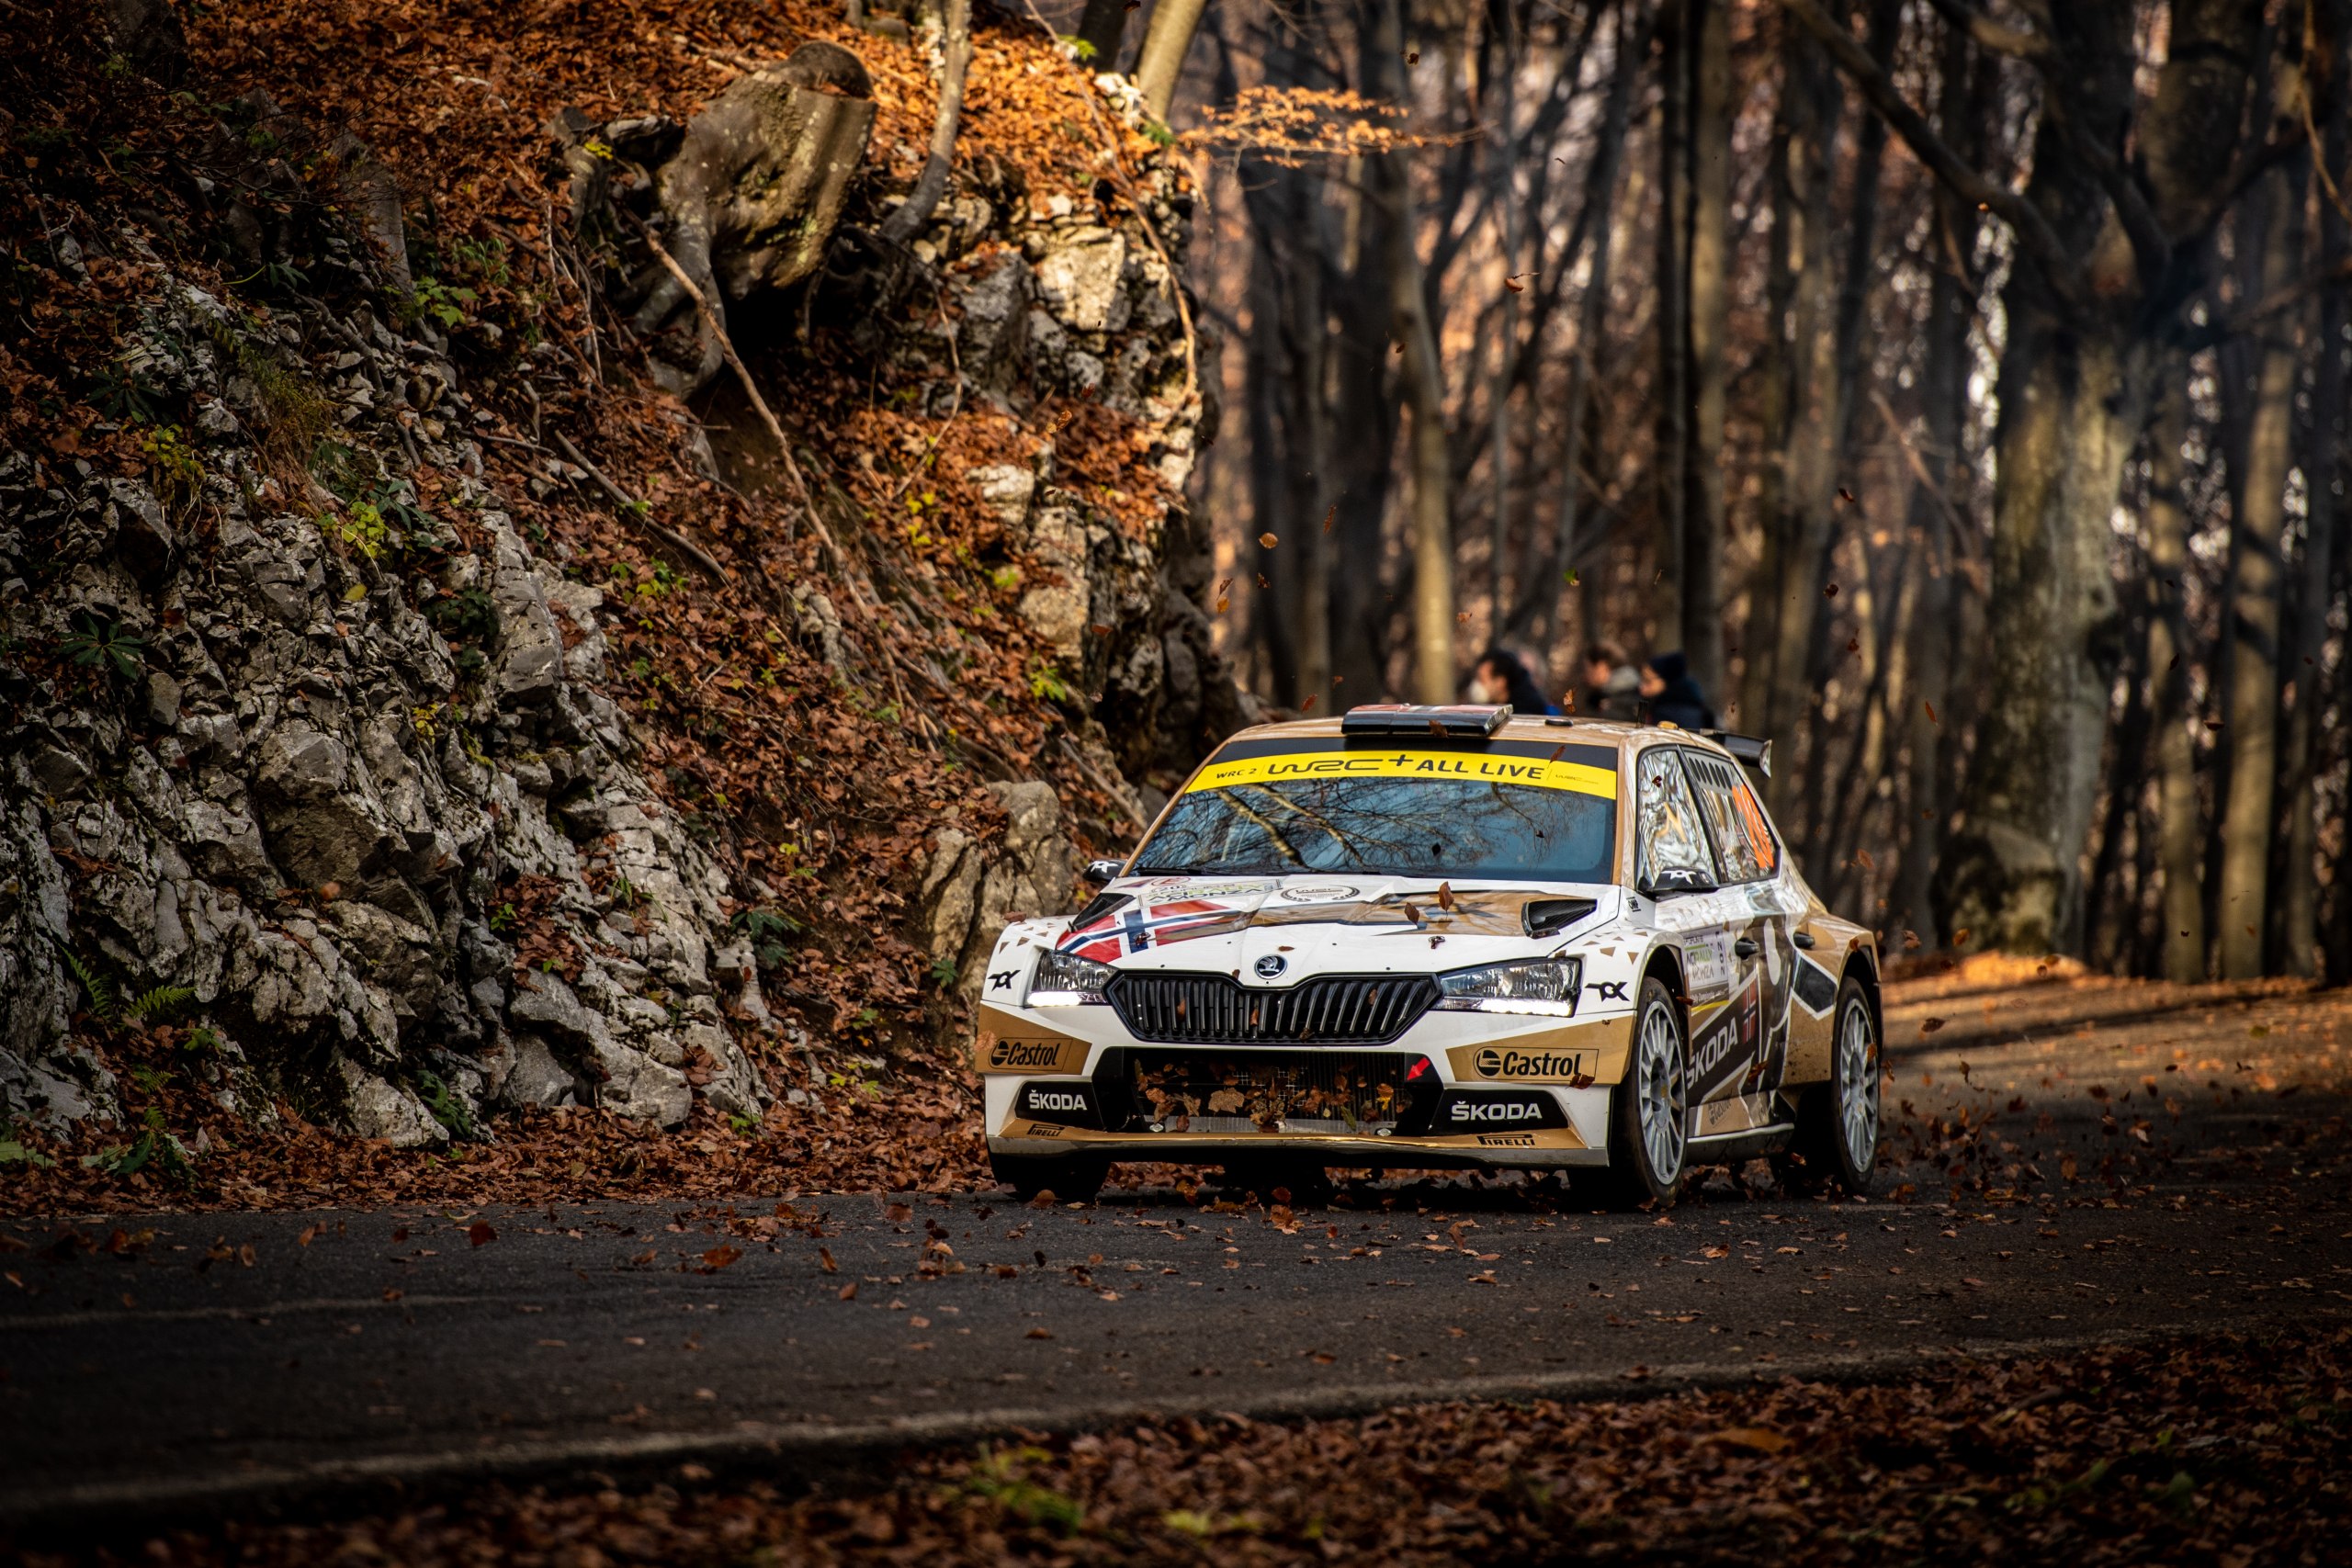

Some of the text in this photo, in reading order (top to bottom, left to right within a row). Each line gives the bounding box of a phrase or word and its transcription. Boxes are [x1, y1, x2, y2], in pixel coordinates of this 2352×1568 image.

[1216, 769, 1244, 779] WRC
[1415, 759, 1469, 773] ALL
[1480, 762, 1545, 780] LIVE
[1007, 1042, 1060, 1066] Castrol
[1503, 1051, 1581, 1076] Castrol
[1028, 1089, 1088, 1111] ŠKODA
[1451, 1100, 1544, 1121] ŠKODA
[1026, 1123, 1066, 1137] PIRELLI
[1476, 1134, 1536, 1146] PIRELLI
